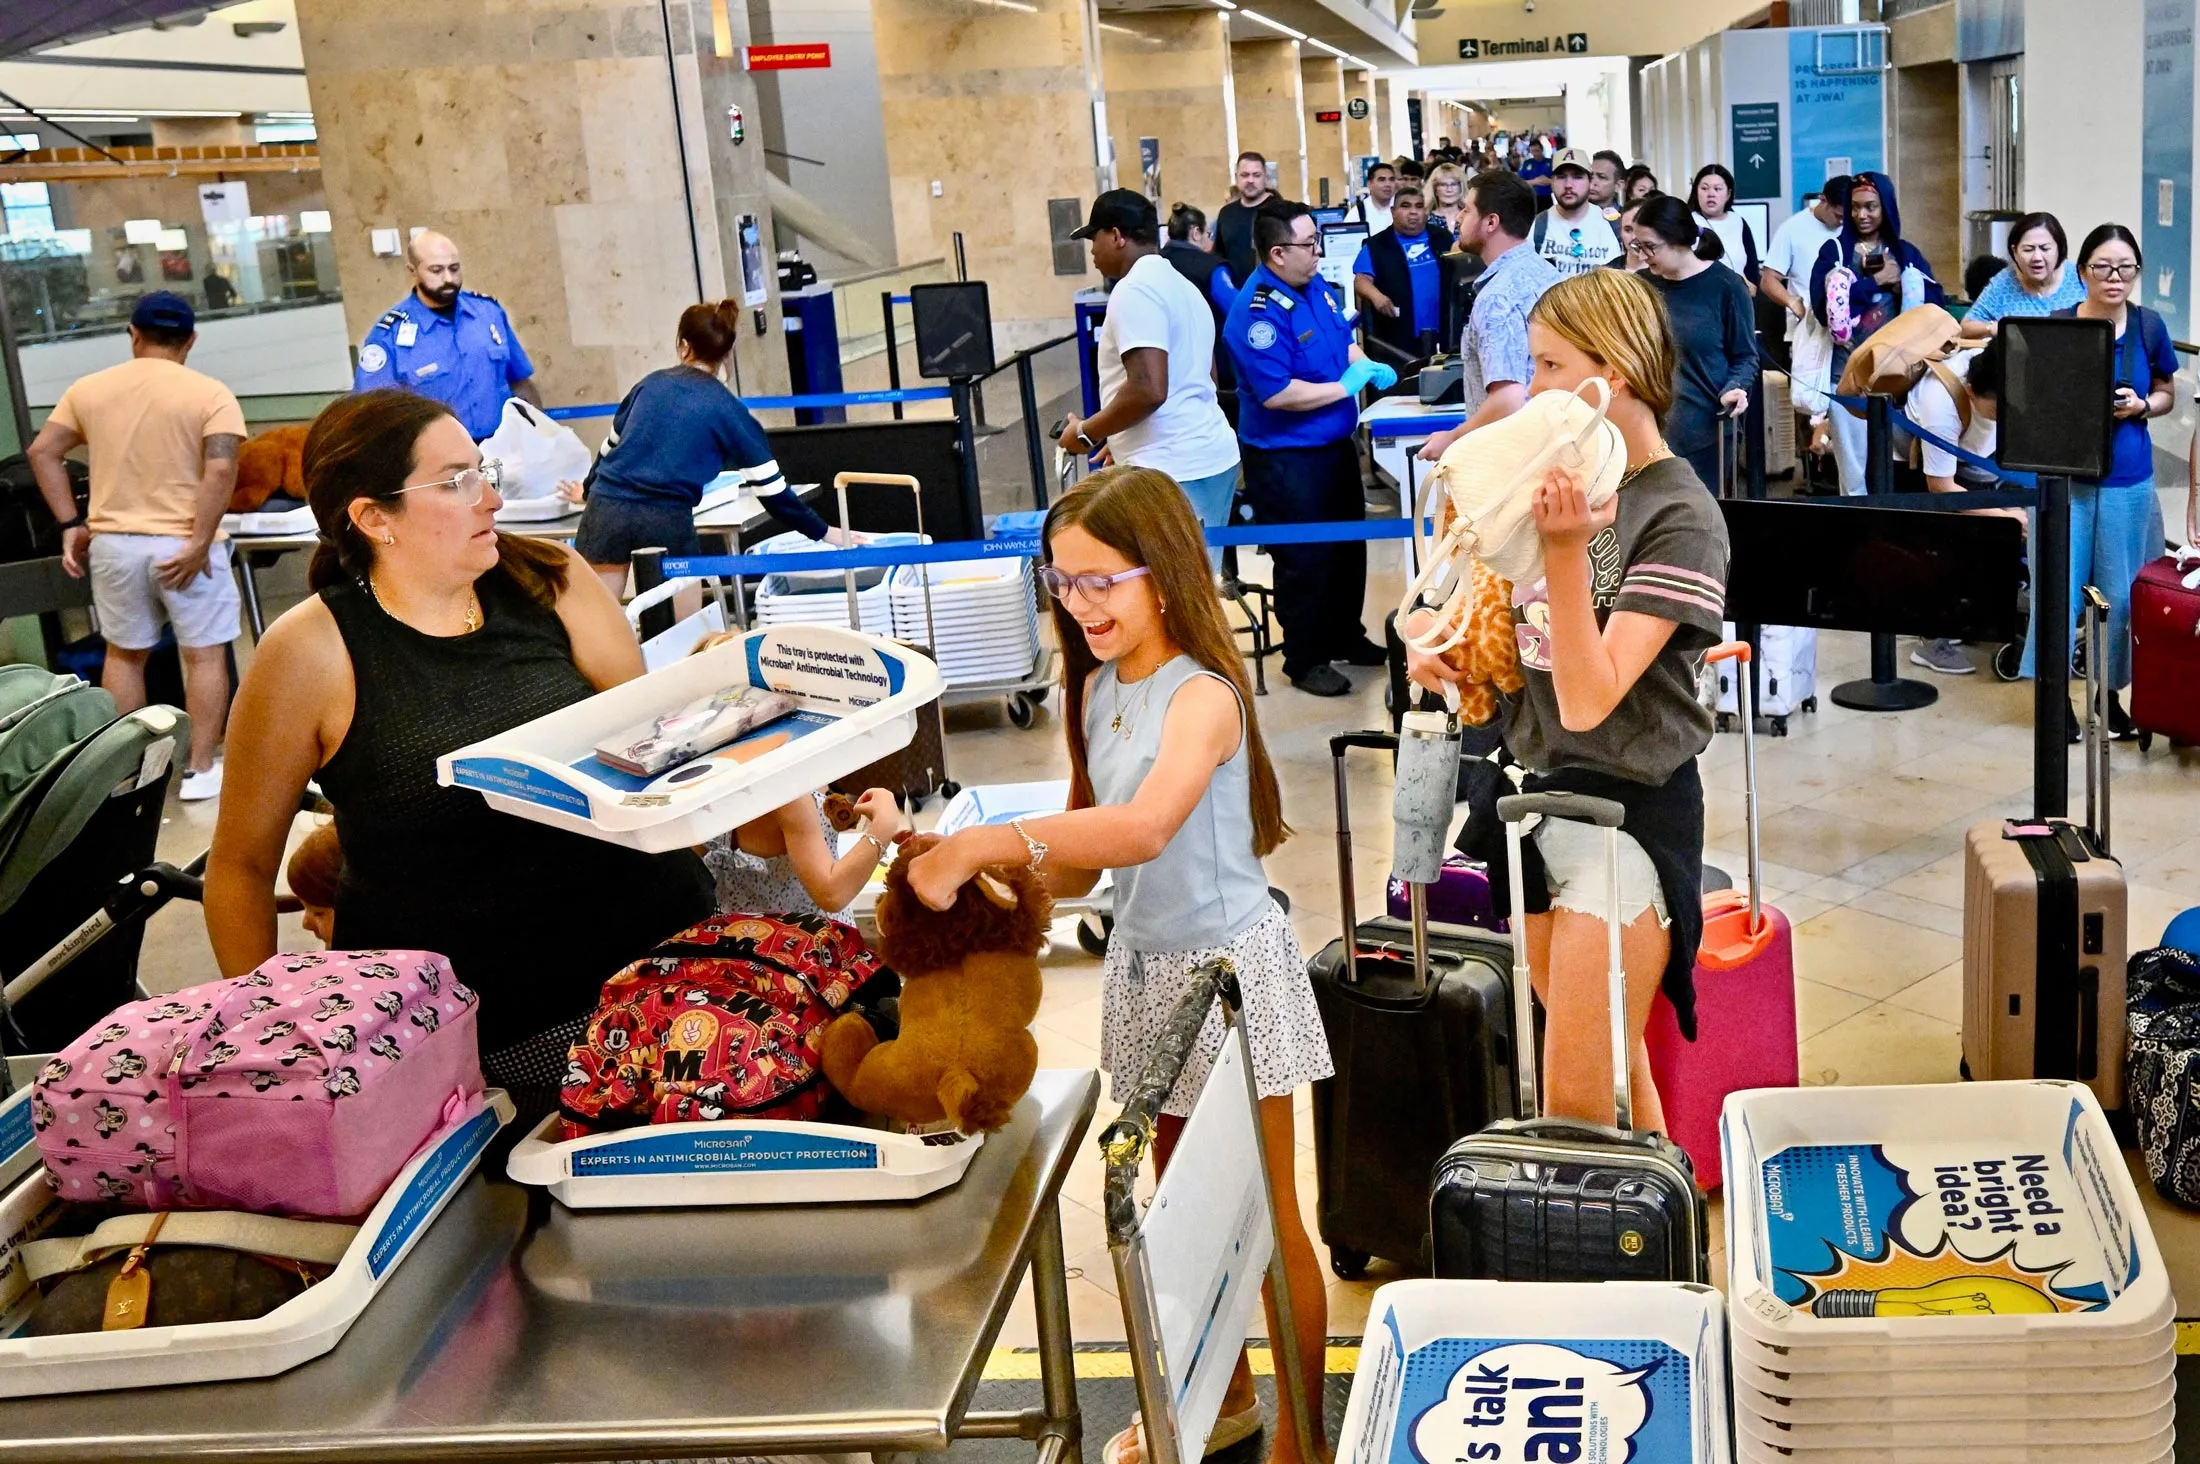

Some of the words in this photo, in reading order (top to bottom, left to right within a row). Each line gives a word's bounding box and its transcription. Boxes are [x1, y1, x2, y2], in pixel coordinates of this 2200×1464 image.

[1481, 37, 1549, 56] Terminal
[1553, 36, 1565, 52] A
[1796, 93, 1810, 104] AT
[1810, 75, 1879, 88] HAPPENING
[983, 542, 1003, 553] JOHN
[1590, 527, 1622, 608] OUSE
[777, 644, 792, 656] This
[793, 647, 806, 660] tray
[807, 648, 813, 659] is
[814, 649, 848, 665] protected
[849, 655, 865, 667] with
[796, 661, 845, 679] Antimicrobial
[845, 669, 888, 688] Technology
[48, 918, 102, 968] mockingbird
[580, 1155, 630, 1165] EXPERTS
[634, 1154, 646, 1163] IN
[649, 1152, 737, 1163] ANTIMICROBIAL
[740, 1151, 792, 1161] PRODUCT
[796, 1150, 867, 1159] PROTECTION
[1848, 1154, 1865, 1195] INNOVATE
[373, 1231, 397, 1264] EXPERTS
[402, 1178, 442, 1227] ANTIMICROBIAL
[440, 1150, 464, 1179] PRODUCT
[462, 1115, 494, 1152] PROTECTION
[1766, 1164, 1784, 1216] MICROBAN
[1835, 1163, 1851, 1202] FRESHER
[1934, 1166, 1982, 1231] idea?
[1973, 1160, 2024, 1233] bright
[2012, 1154, 2064, 1215] Need
[1842, 1202, 1858, 1247] PRODUCTS.
[1854, 1195, 1867, 1218] WITH
[1858, 1215, 1876, 1255] CLEANER,
[2033, 1222, 2061, 1235] a
[1463, 1363, 1510, 1428] talk
[1589, 1401, 1599, 1420] WITH
[1512, 1377, 1585, 1464] an!
[1588, 1420, 1599, 1461] SOLUTIONS
